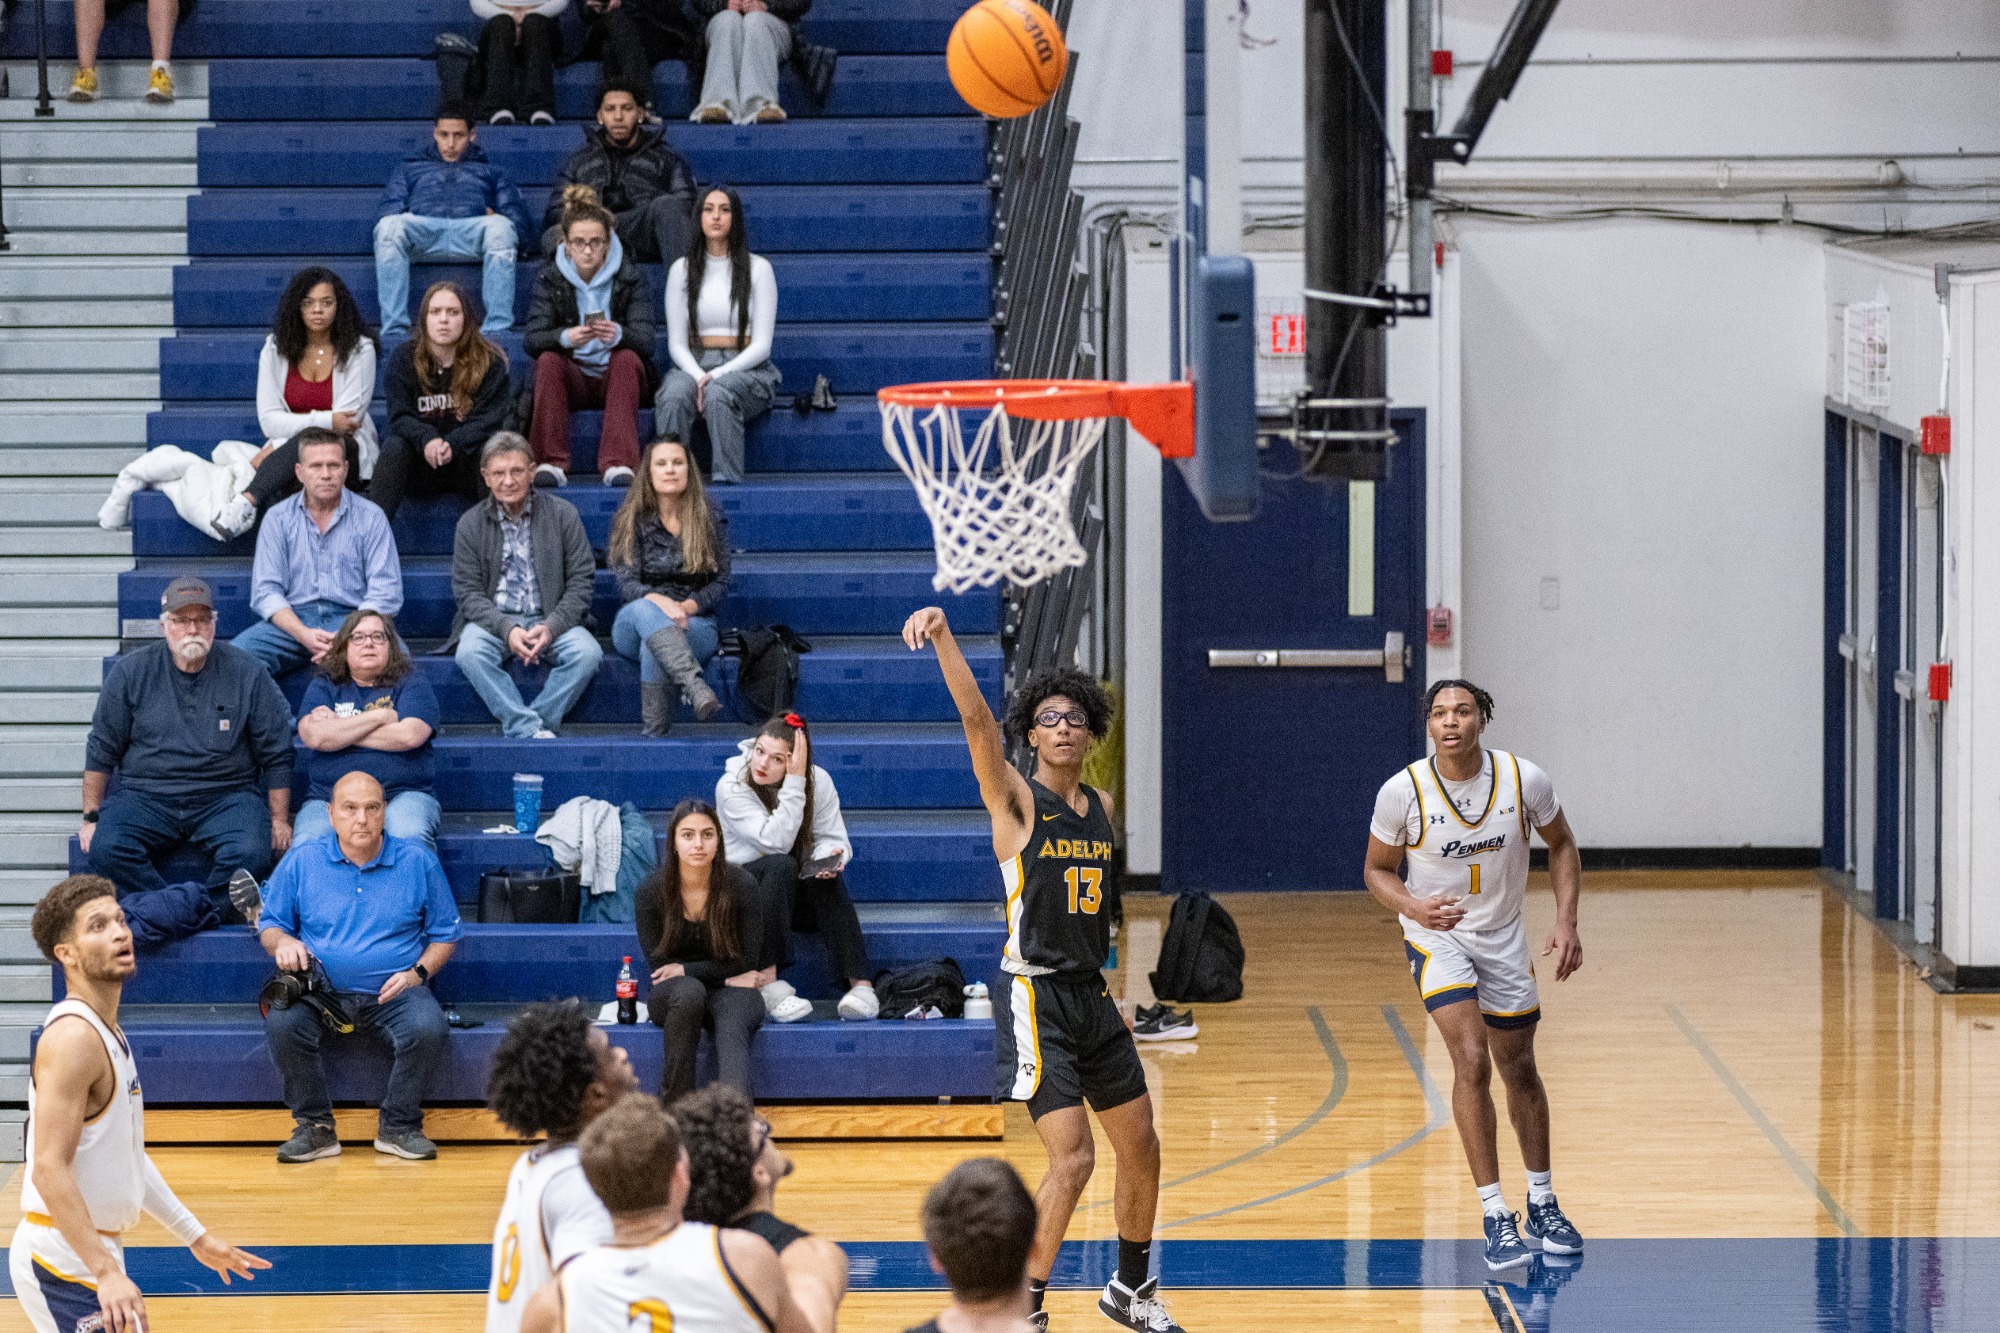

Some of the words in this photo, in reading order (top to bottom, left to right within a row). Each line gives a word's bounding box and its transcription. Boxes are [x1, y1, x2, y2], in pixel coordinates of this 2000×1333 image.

[1272, 315, 1306, 353] EXI
[1038, 837, 1111, 861] ADELPH
[1064, 866, 1102, 914] 13
[1467, 864, 1481, 894] 1
[498, 1223, 521, 1302] 0
